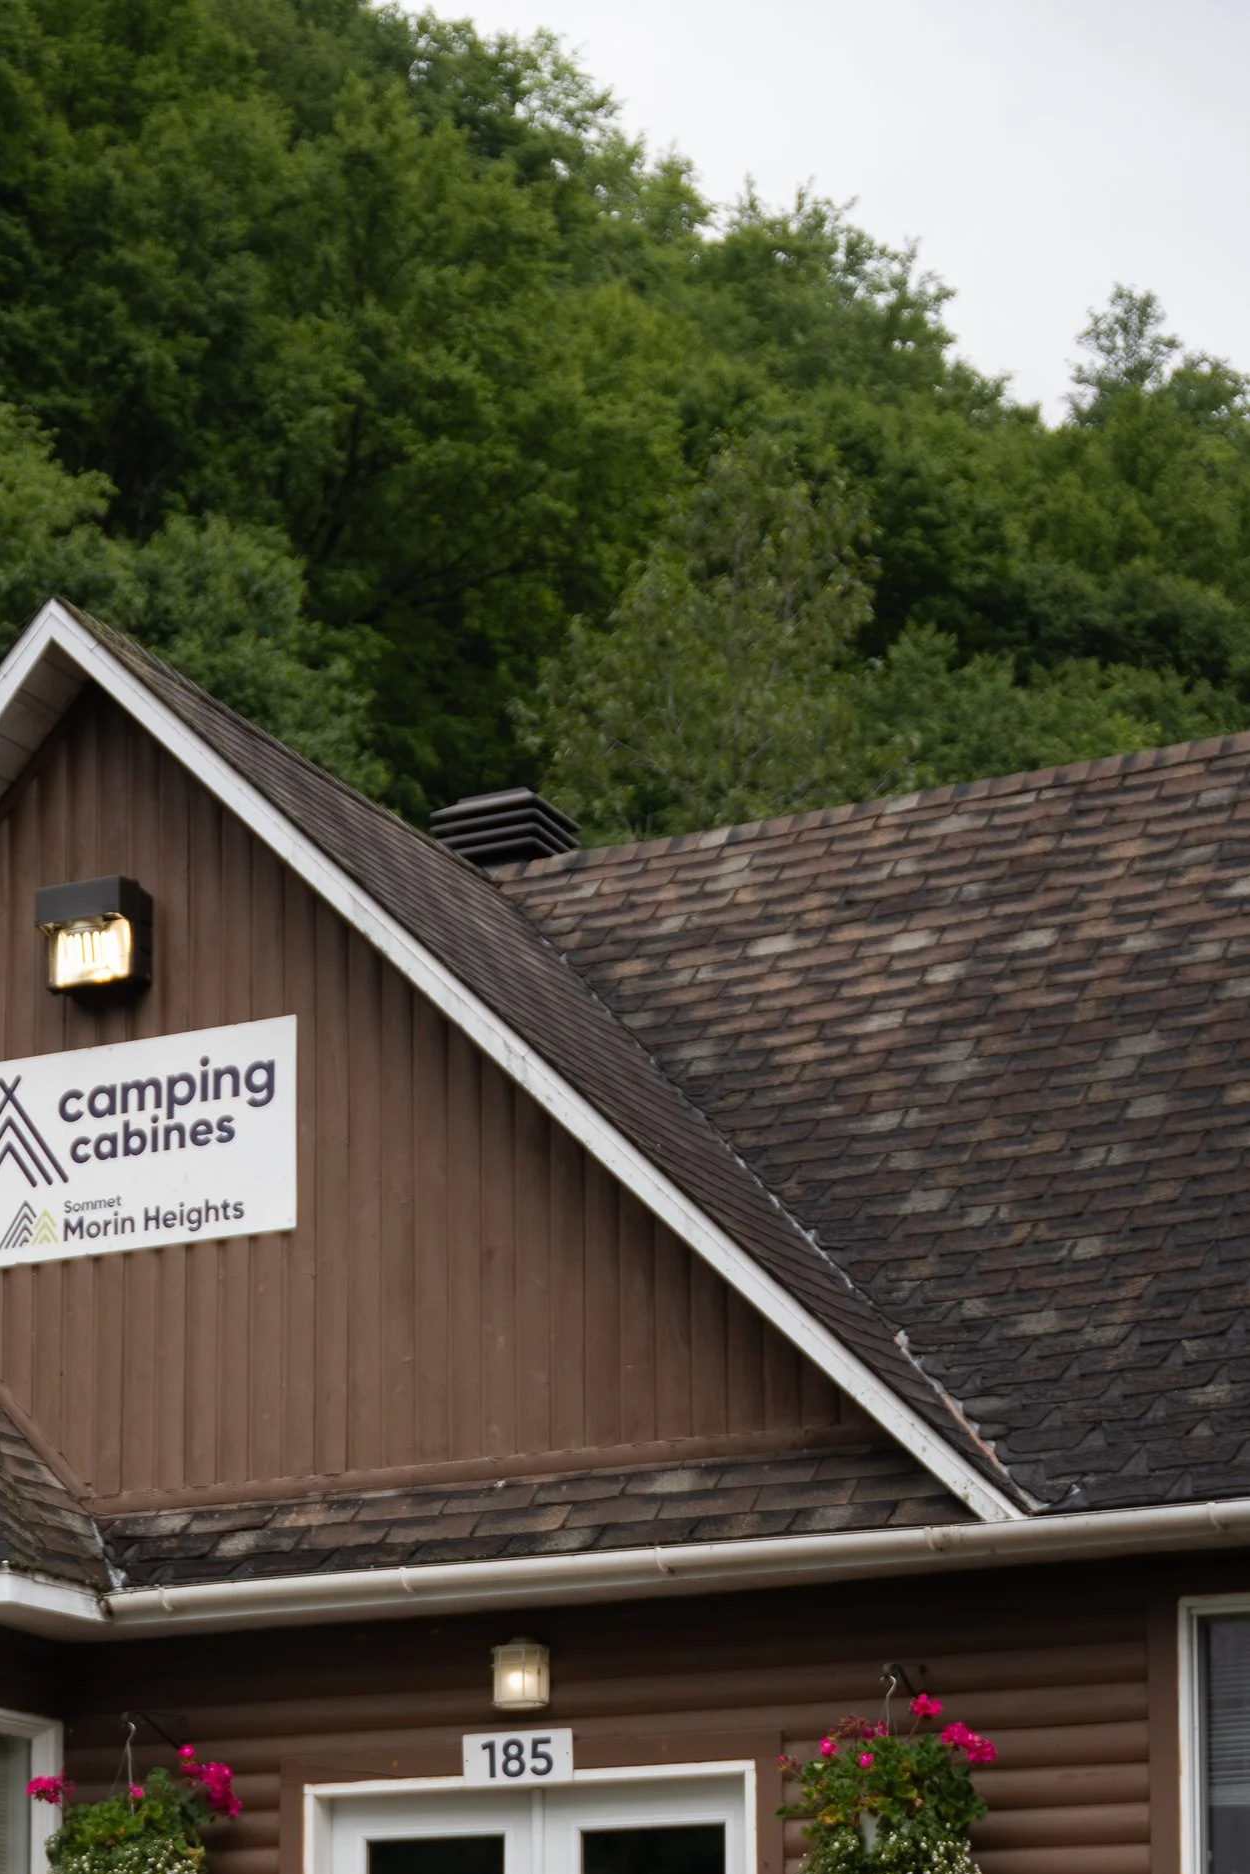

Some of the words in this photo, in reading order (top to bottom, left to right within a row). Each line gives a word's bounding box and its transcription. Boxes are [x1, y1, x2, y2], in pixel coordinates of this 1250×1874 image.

[58, 1055, 275, 1122] camping
[70, 1113, 235, 1163] cabines
[63, 1195, 122, 1214] Sommet
[63, 1210, 135, 1242] Morin
[143, 1198, 245, 1232] Heights
[481, 1736, 553, 1778] 185
